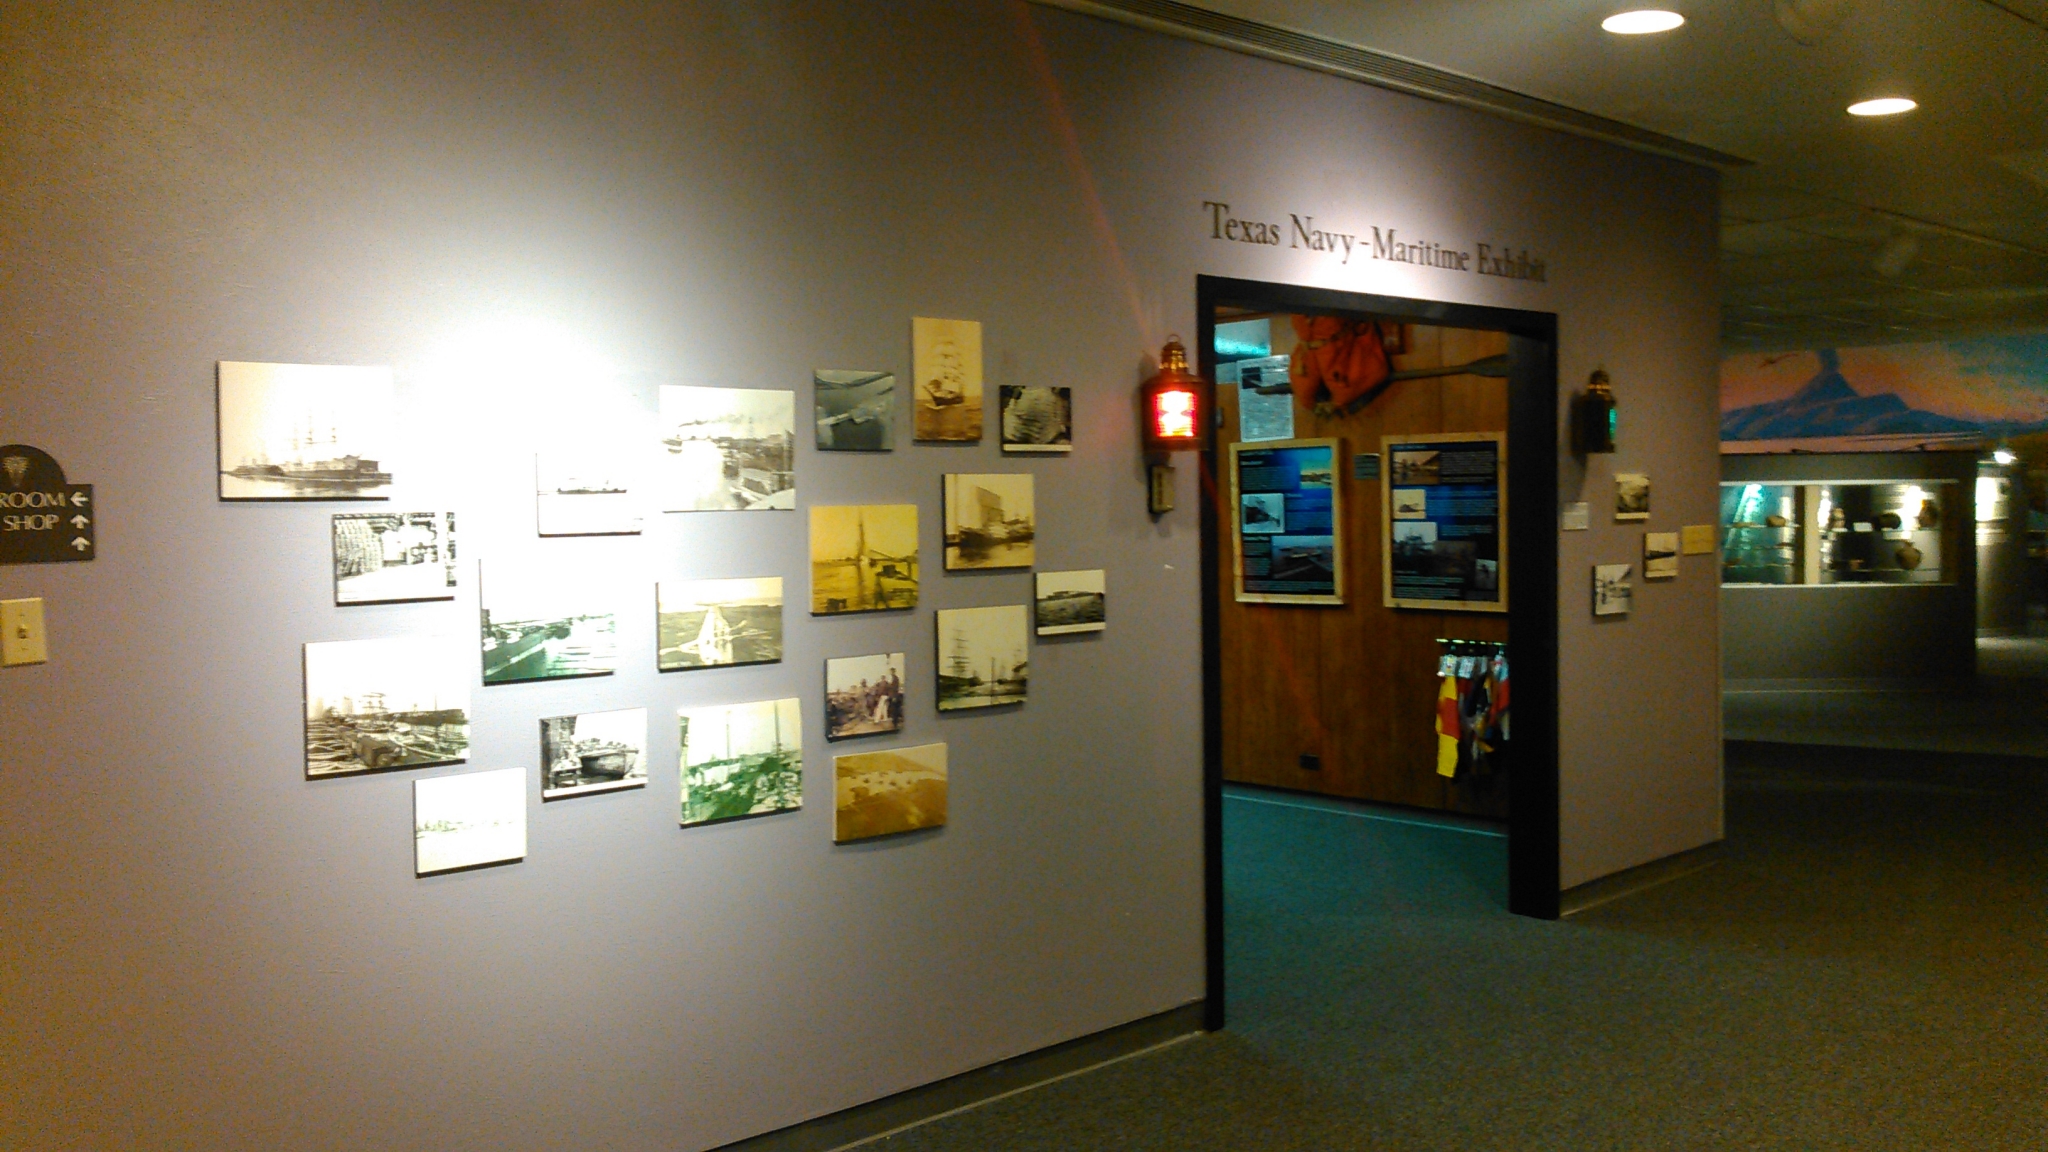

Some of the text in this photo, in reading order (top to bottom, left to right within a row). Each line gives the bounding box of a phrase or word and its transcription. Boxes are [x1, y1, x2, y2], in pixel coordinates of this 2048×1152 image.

[1203, 201, 1280, 246] Texas
[1477, 243, 1546, 282] Exhibit
[3, 514, 60, 531] SHOP
